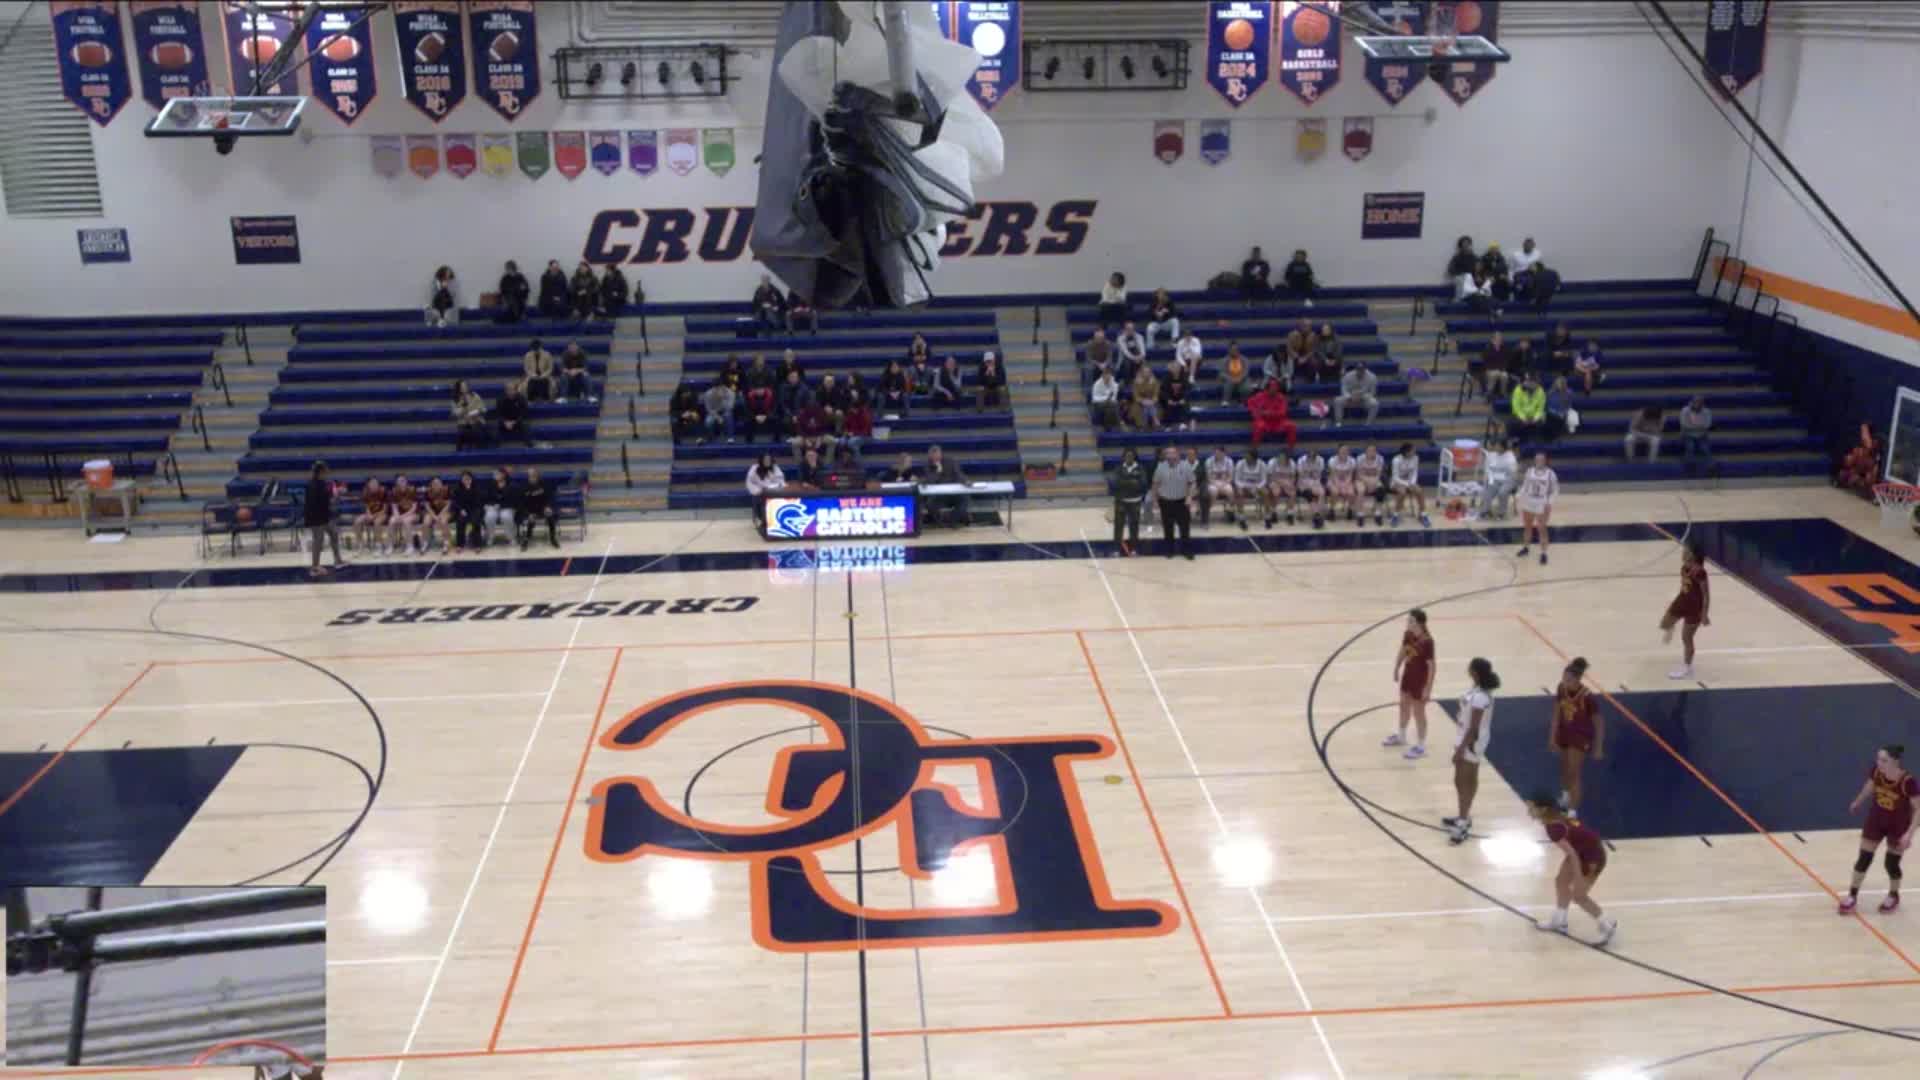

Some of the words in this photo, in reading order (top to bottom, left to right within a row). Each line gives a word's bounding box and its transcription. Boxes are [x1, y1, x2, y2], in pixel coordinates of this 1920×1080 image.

[583, 199, 1098, 265] CRUERS
[840, 498, 857, 507] WE
[860, 497, 883, 507] ARE
[815, 521, 907, 536] CATHOLIC
[326, 596, 760, 626] CRUSADERS
